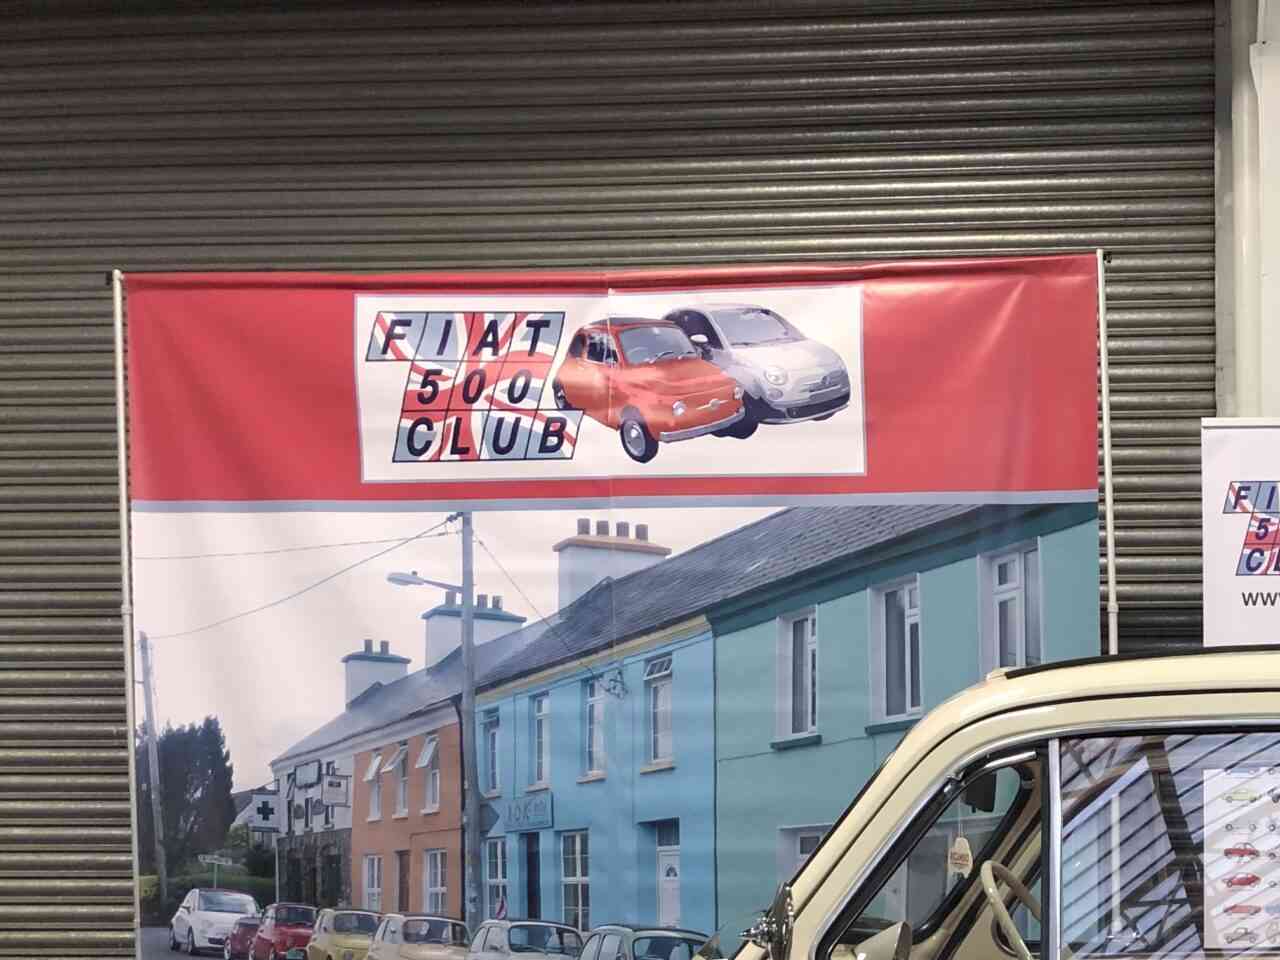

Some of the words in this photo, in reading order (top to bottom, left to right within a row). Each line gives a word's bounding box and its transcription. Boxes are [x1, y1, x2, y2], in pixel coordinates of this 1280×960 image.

[381, 319, 551, 357] FIAT
[416, 368, 532, 405] 500
[406, 416, 568, 457] CLUB
